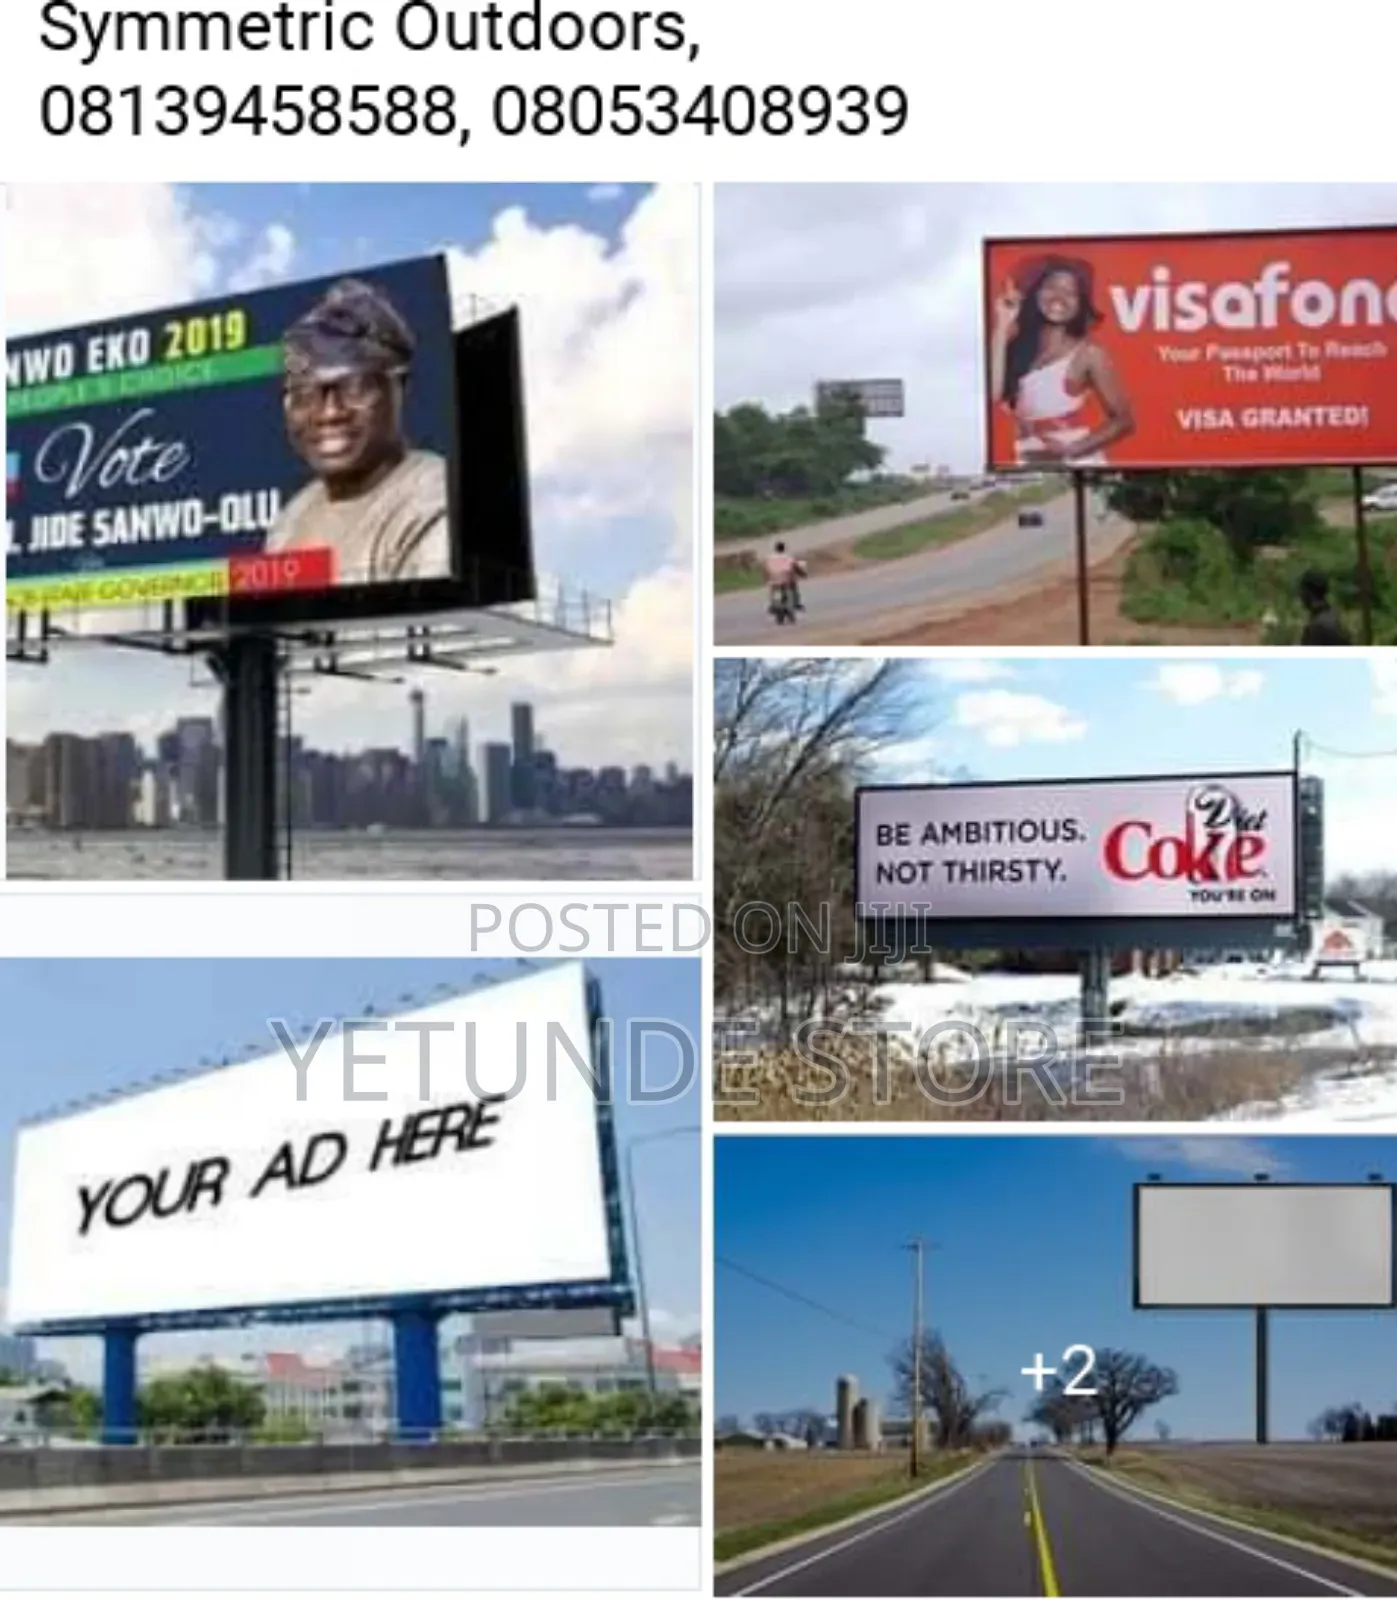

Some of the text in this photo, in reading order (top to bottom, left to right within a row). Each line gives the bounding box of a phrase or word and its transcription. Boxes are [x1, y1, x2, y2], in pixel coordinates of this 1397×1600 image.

[87, 328, 149, 373] EKO
[164, 309, 246, 361] 2019
[1158, 345, 1200, 364] Your
[1206, 342, 1292, 365] Passport
[1298, 341, 1319, 359] To
[1223, 364, 1322, 383] The World
[1178, 405, 1370, 431] VISA GRANTED!
[34, 407, 191, 500] Vote
[29, 512, 85, 552] JIDE
[92, 488, 279, 547] SANWO-OLU
[232, 560, 301, 590] 2019
[1189, 785, 1268, 832] Diet
[876, 818, 1087, 847] BE AMBITIOUS.
[1104, 812, 1268, 884] Coke
[875, 857, 1068, 885] NOT THIRSTY.
[1250, 887, 1277, 902] ON
[79, 1093, 506, 1236] YOUR AD HERE
